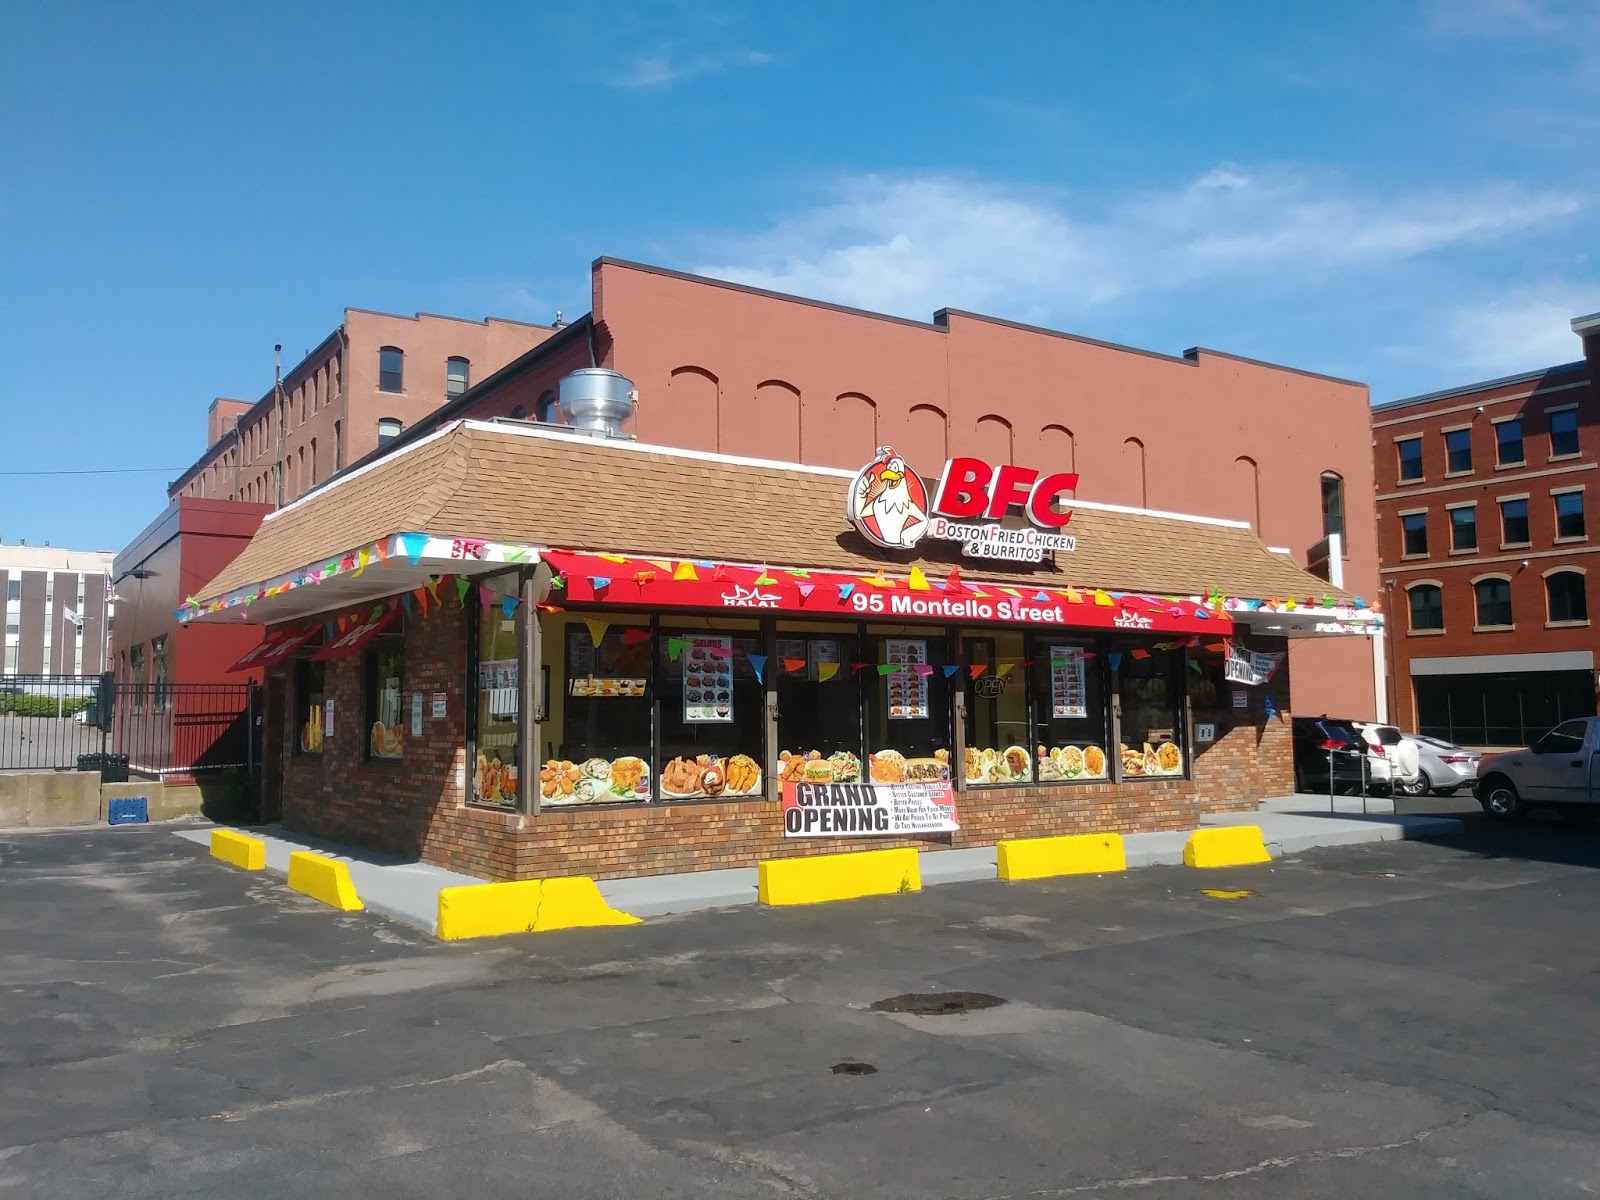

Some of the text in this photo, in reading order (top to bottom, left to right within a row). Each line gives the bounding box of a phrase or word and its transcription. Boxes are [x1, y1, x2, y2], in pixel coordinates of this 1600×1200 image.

[933, 457, 1080, 528] BFC
[936, 520, 1075, 550] BOSTON FRIED CHICKEN
[970, 542, 1041, 560] & BURRITOS
[724, 599, 779, 608] HALAL
[852, 593, 884, 613] 95
[891, 595, 993, 618] Montello
[1115, 621, 1152, 629] HALAL
[975, 678, 1007, 694] OPEN
[796, 782, 878, 807] GRAND
[786, 807, 889, 833] OPENING
